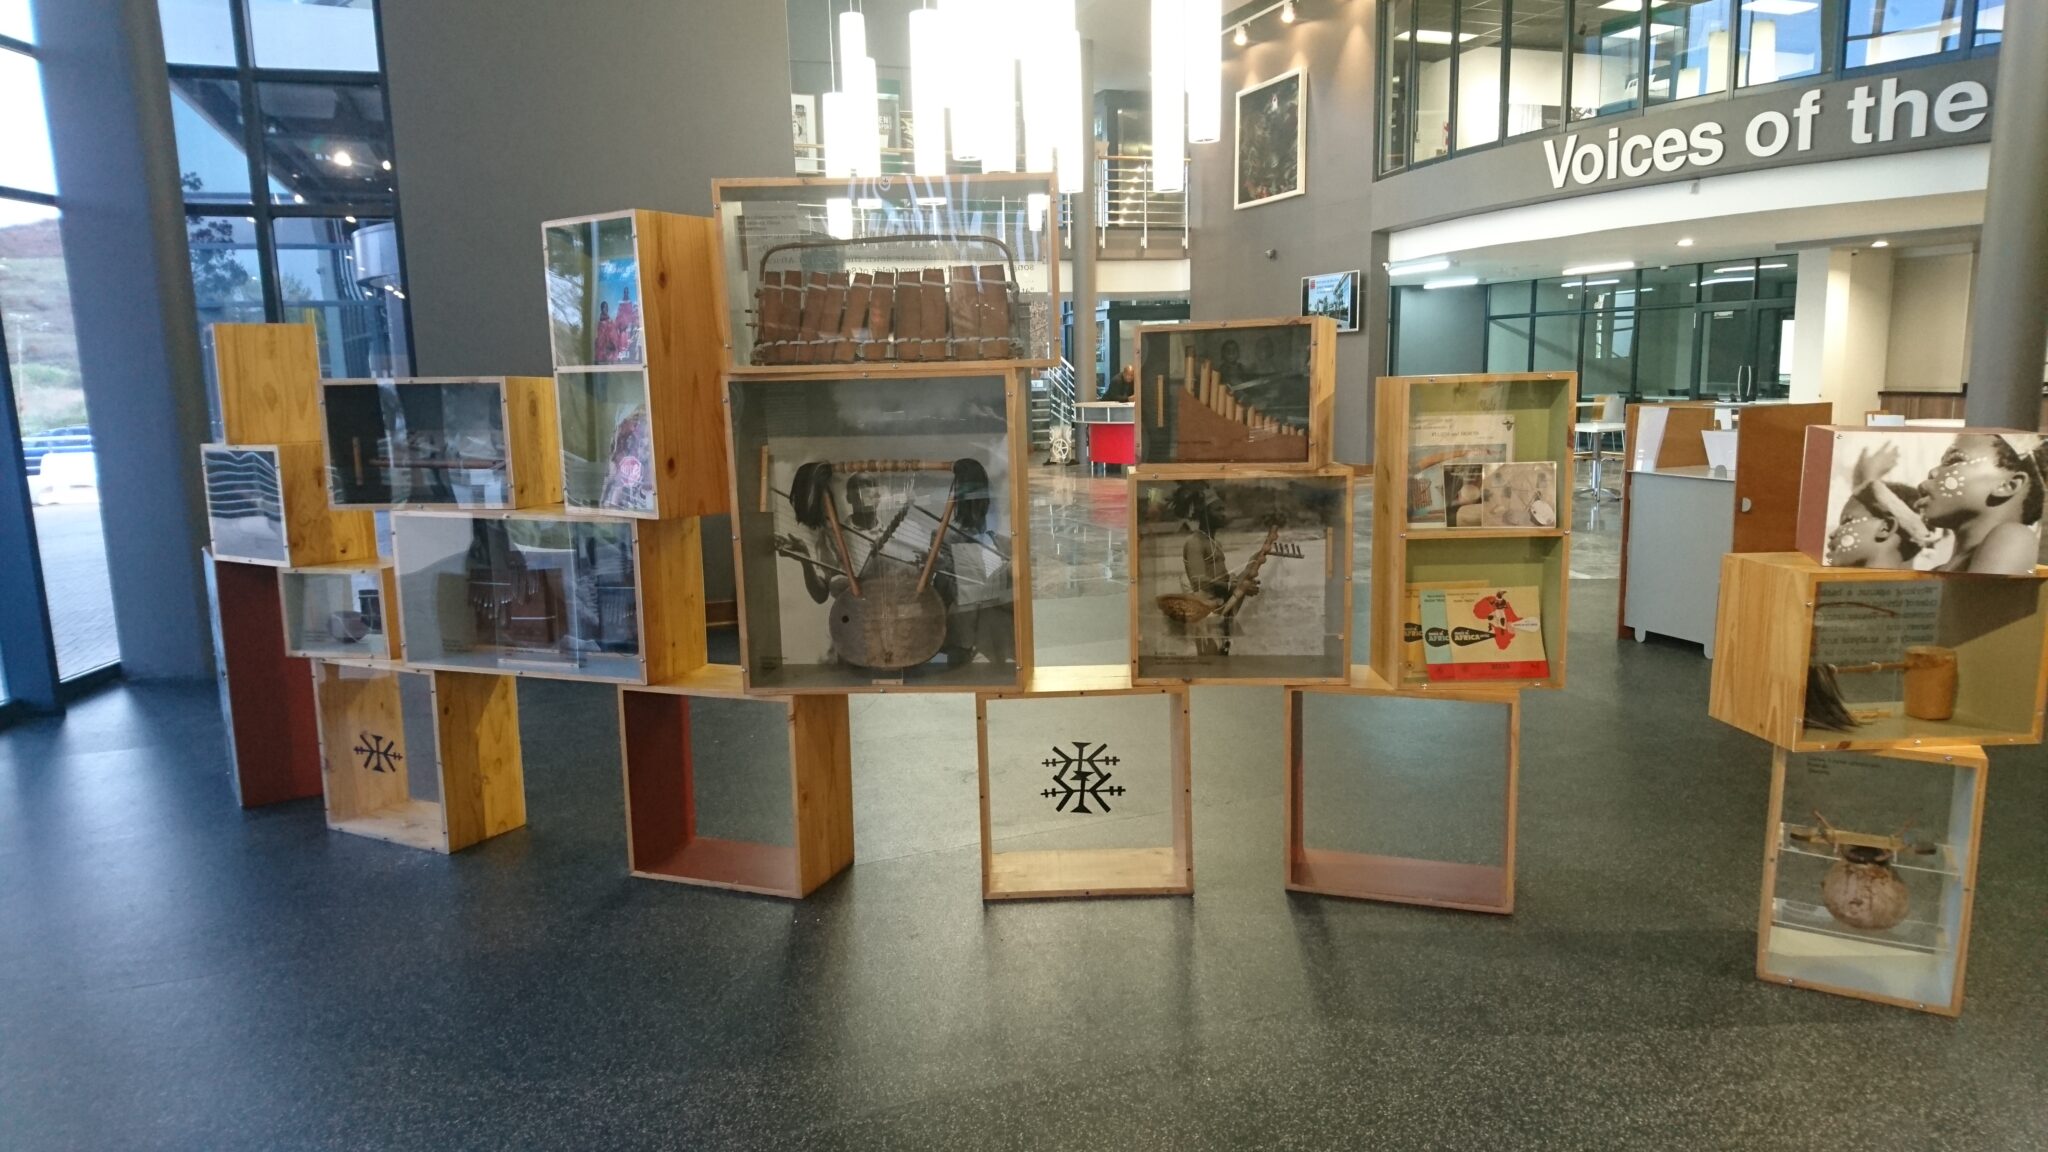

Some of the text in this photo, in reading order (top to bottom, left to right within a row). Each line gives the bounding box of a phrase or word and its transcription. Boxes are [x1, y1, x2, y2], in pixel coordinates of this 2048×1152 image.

[1543, 77, 1989, 189] Voices of the
